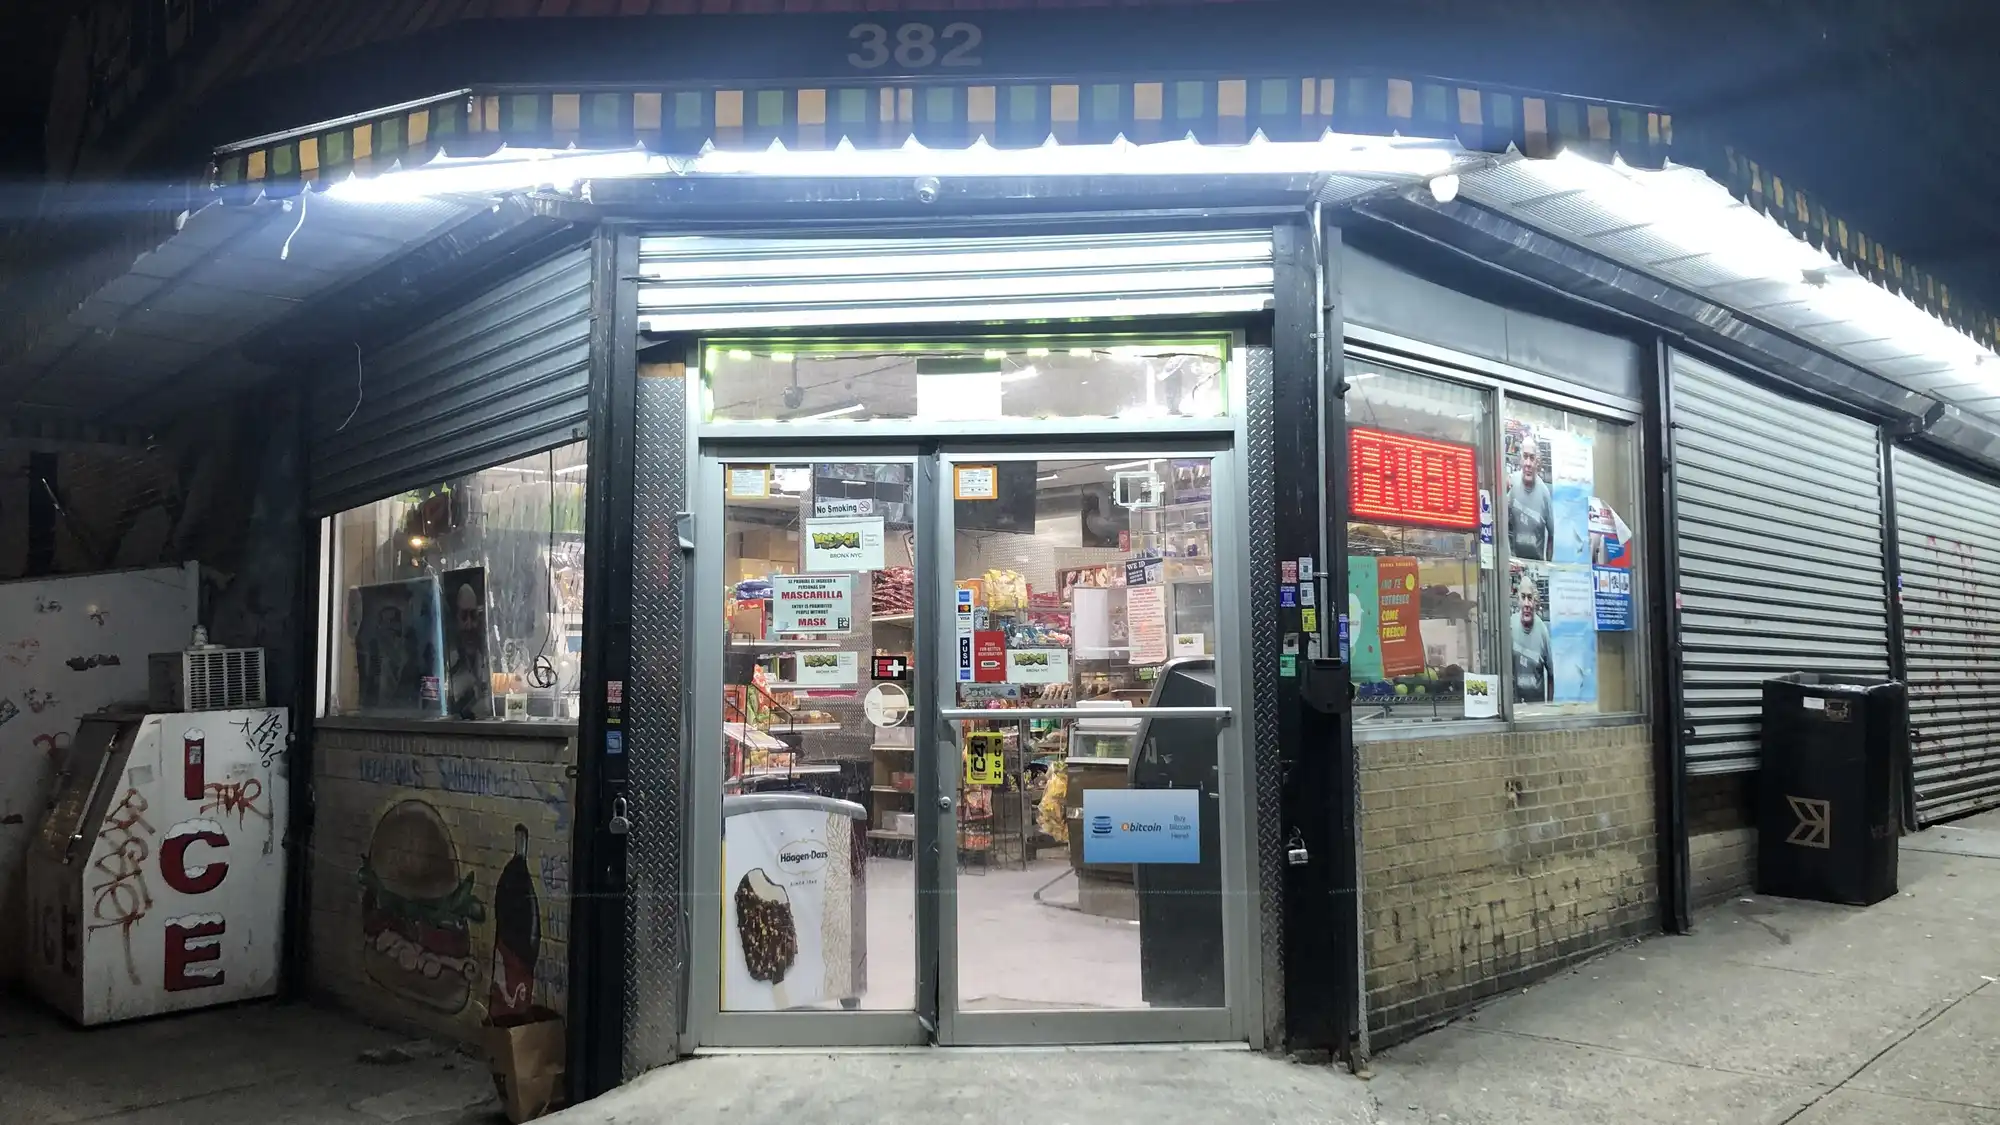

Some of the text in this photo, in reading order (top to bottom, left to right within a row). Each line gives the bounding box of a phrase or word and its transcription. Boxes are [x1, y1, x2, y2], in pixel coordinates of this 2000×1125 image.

[847, 22, 982, 69] 382
[816, 504, 857, 514] No Smoking
[781, 591, 843, 600] MASCARILLA
[798, 618, 827, 626] MASK
[994, 738, 1002, 778] PUSH
[1130, 822, 1162, 832] bitcoin
[159, 727, 230, 992] ICE
[780, 850, 828, 864] Häagen-Dazs
